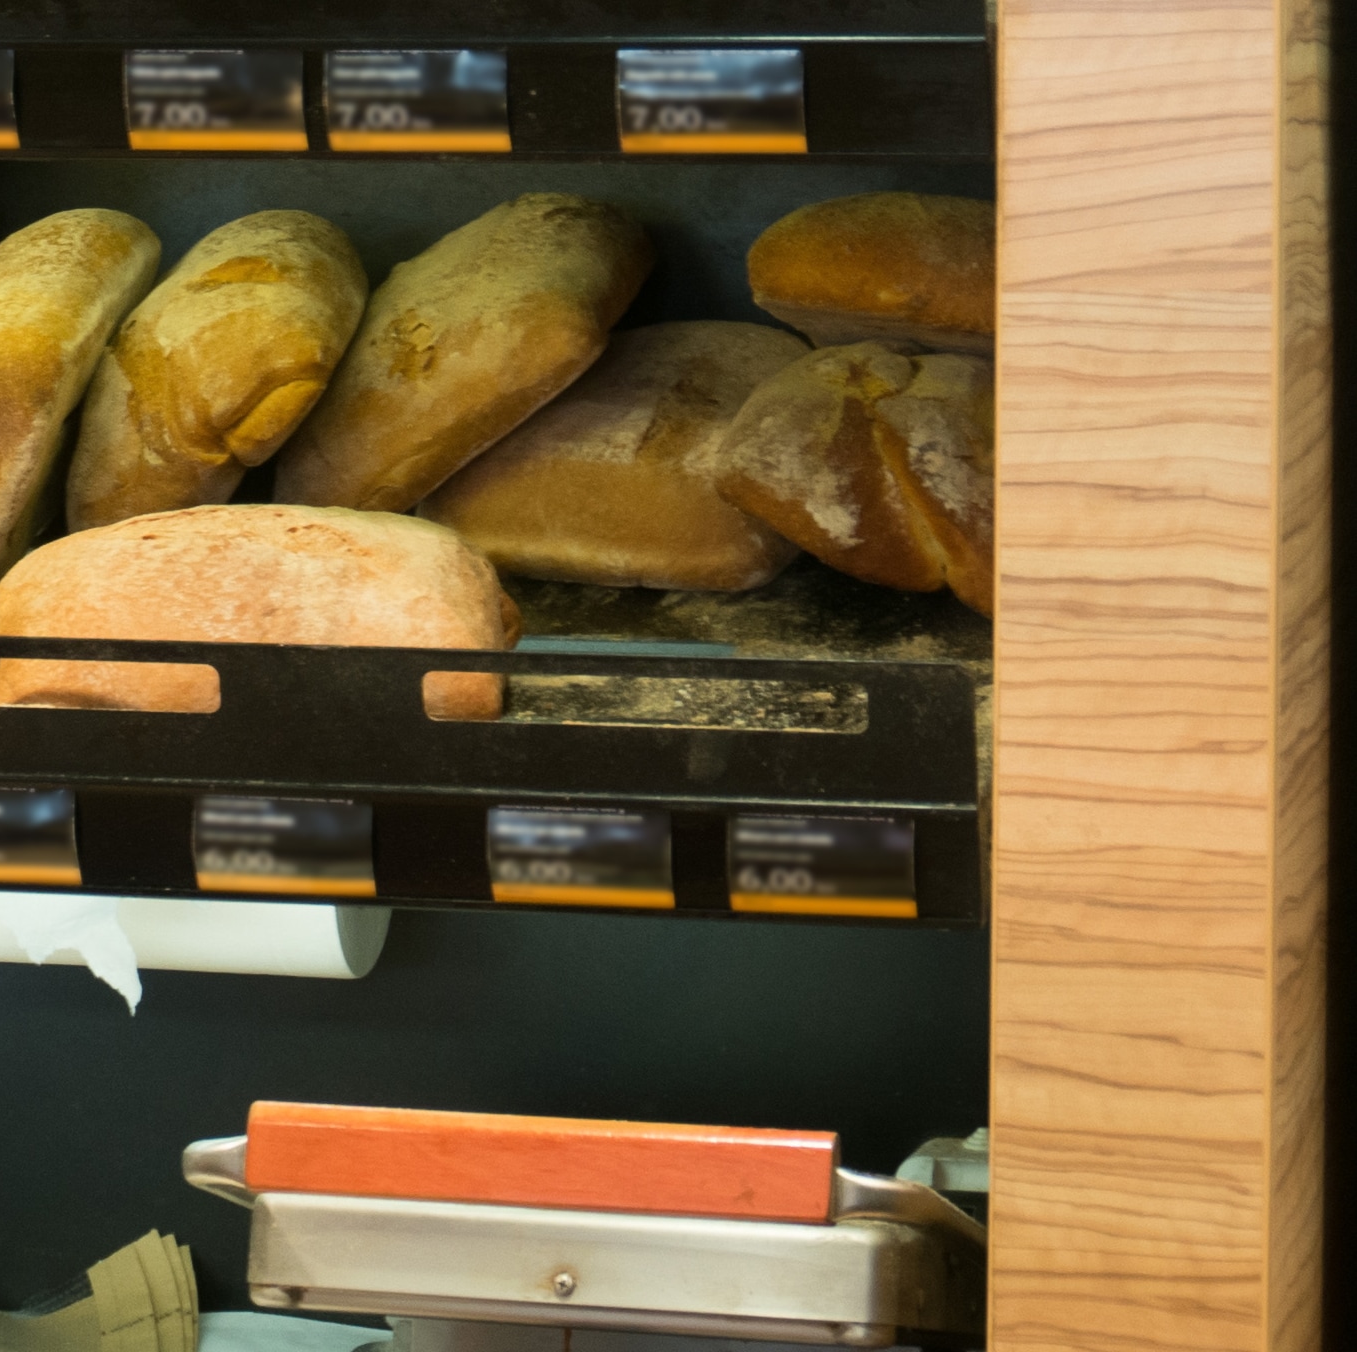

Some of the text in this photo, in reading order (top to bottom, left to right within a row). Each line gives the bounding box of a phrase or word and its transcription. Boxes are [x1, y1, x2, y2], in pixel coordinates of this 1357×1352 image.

[136, 103, 207, 130] 7,00
[337, 103, 409, 131] 7,00
[630, 105, 704, 132] 7,00
[204, 848, 275, 875] 6,00
[738, 867, 812, 895] 6,00
